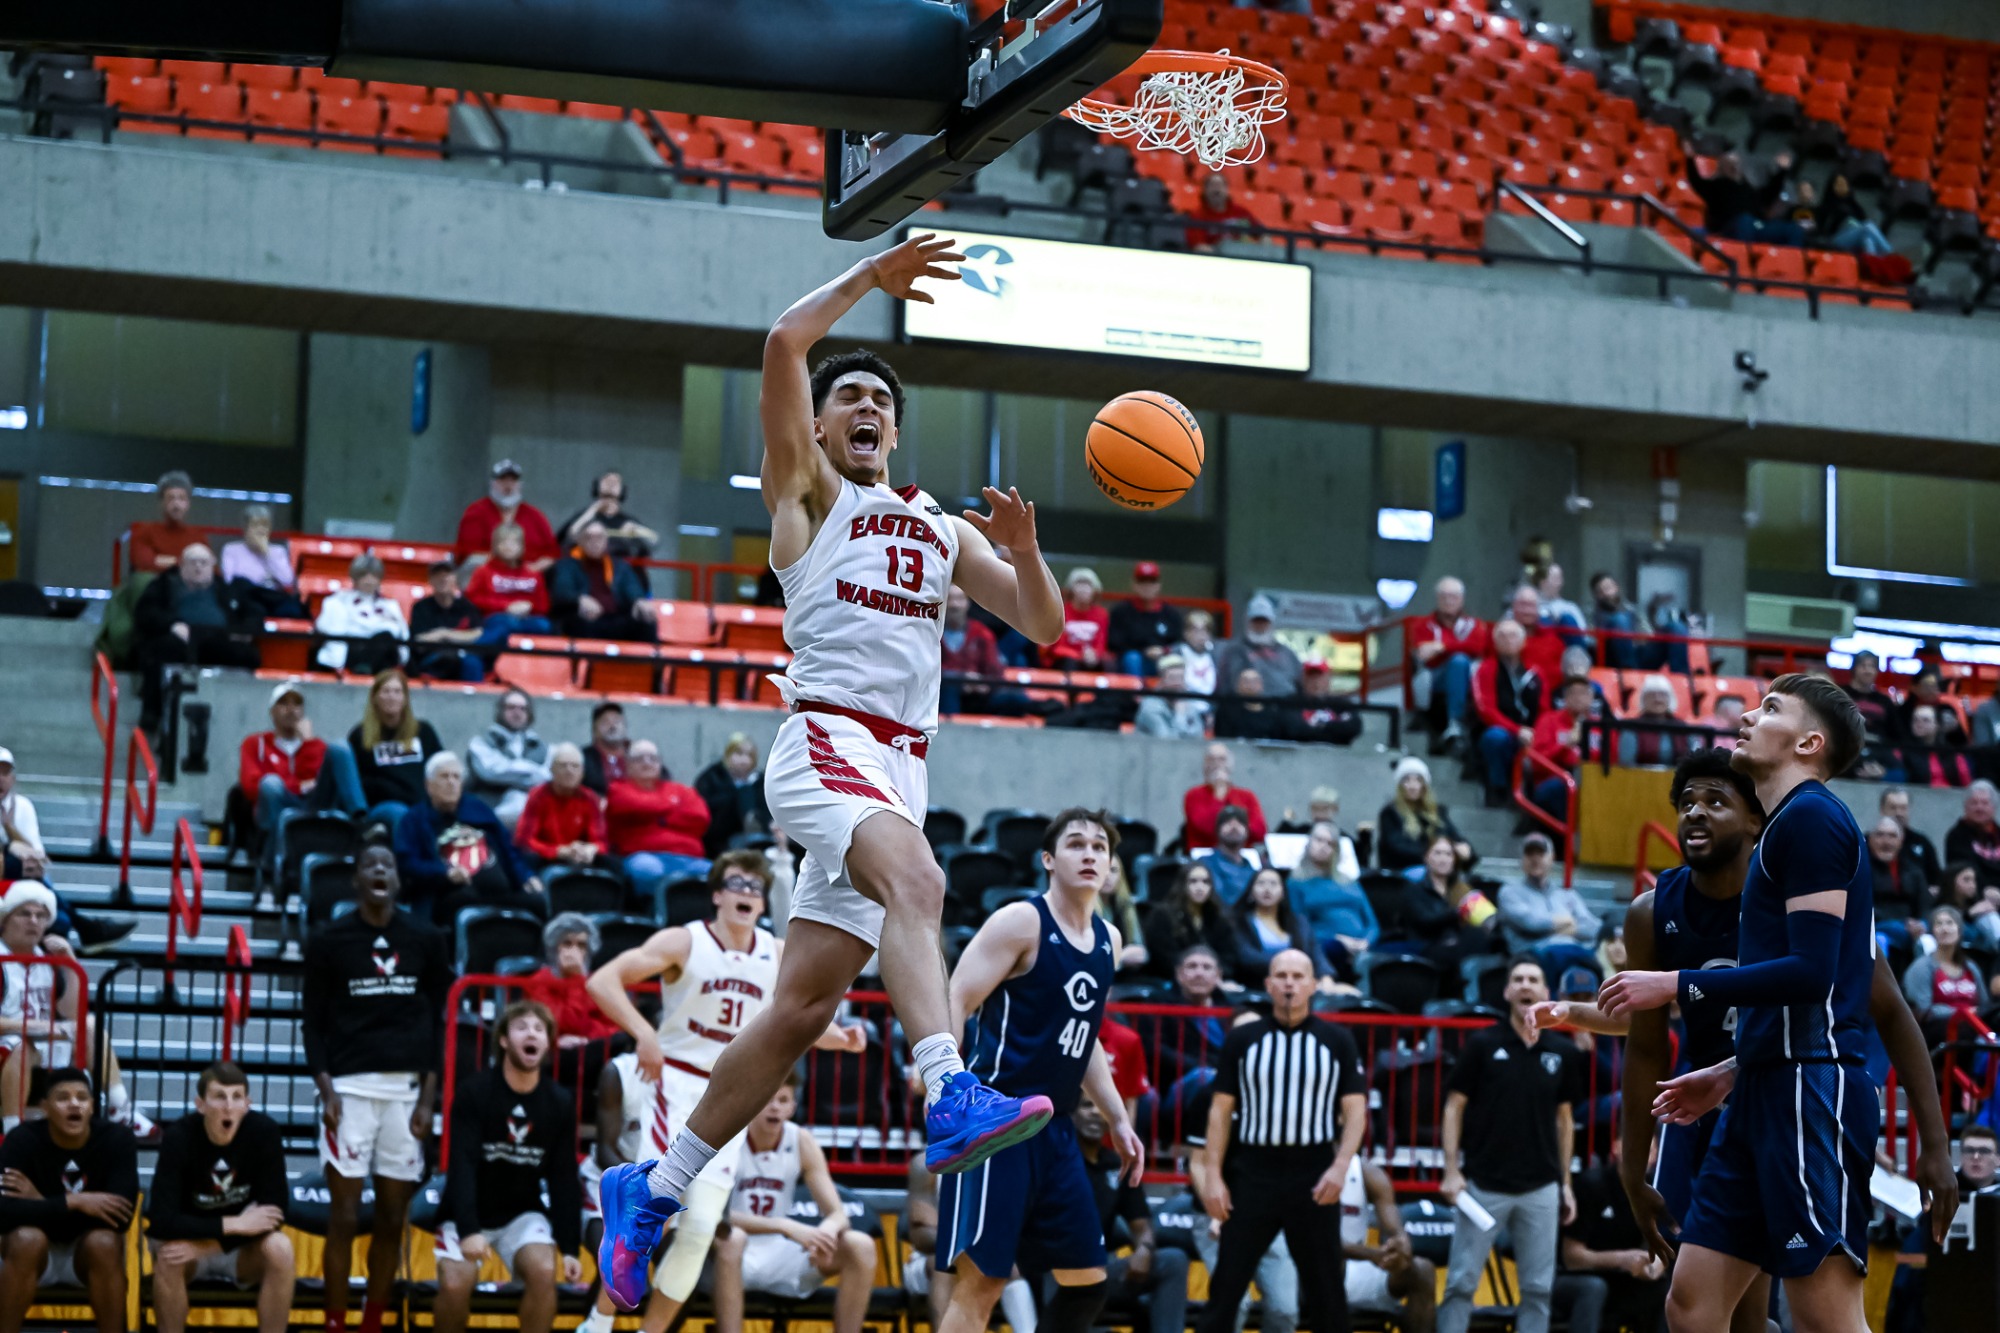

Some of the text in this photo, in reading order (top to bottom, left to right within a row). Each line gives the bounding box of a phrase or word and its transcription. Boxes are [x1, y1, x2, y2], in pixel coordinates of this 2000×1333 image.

[1089, 460, 1155, 508] Wilson
[849, 514, 949, 561] EASTERN
[885, 545, 924, 593] 13
[718, 998, 743, 1027] 31
[1058, 1018, 1090, 1059] 40
